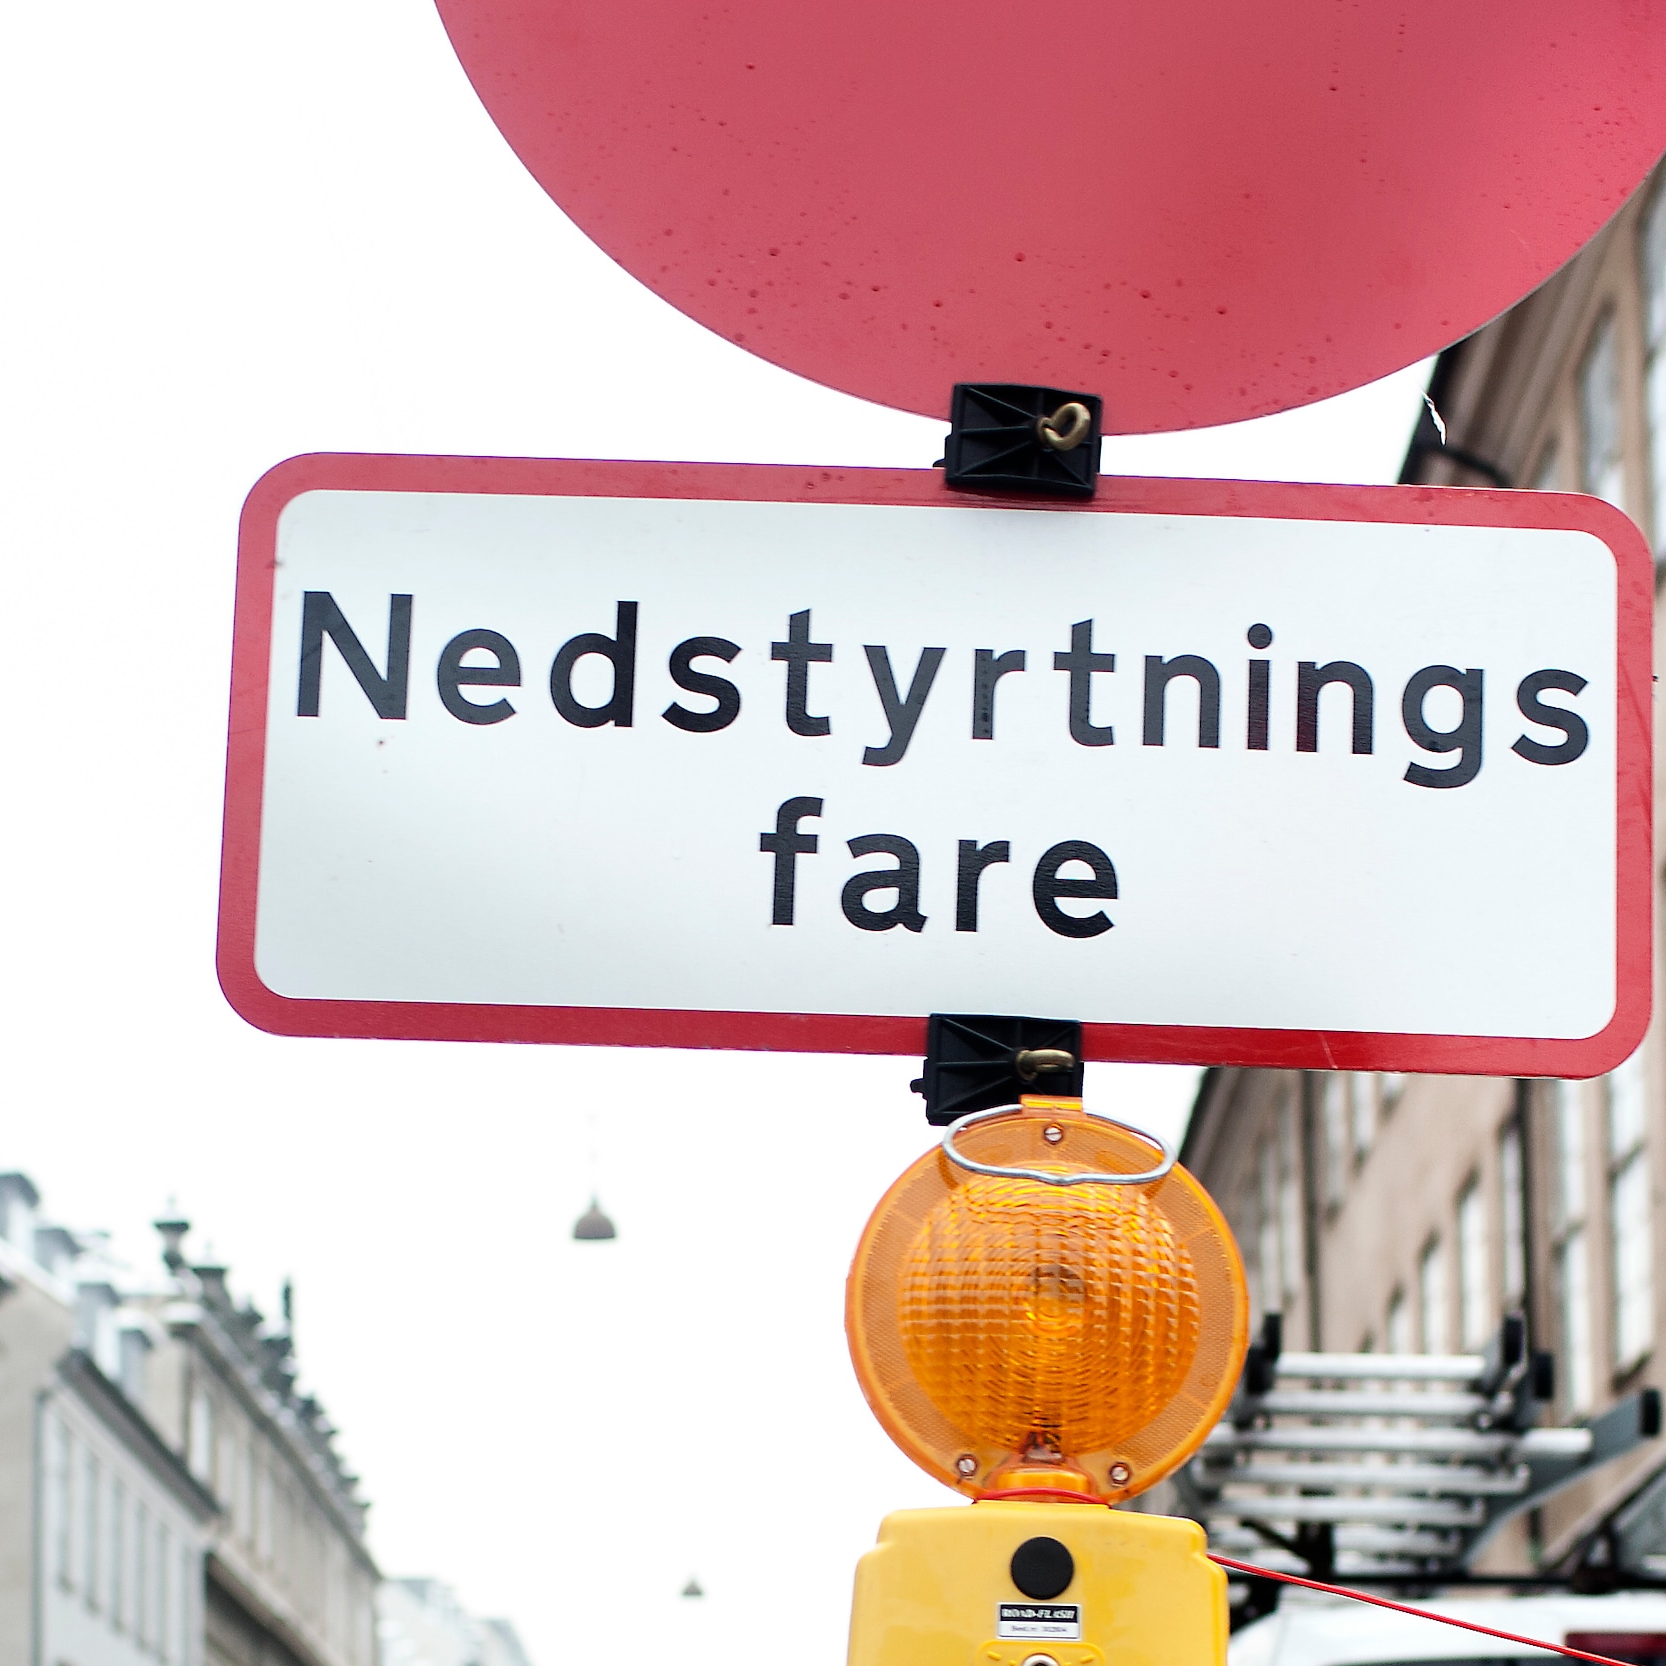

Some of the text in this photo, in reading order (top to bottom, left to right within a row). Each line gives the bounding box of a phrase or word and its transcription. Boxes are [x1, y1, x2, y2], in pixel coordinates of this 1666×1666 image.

[294, 589, 1590, 789] Nedstyrtnings
[759, 796, 1119, 939] fare
[1001, 1607, 1076, 1620] ROAD-FLASH
